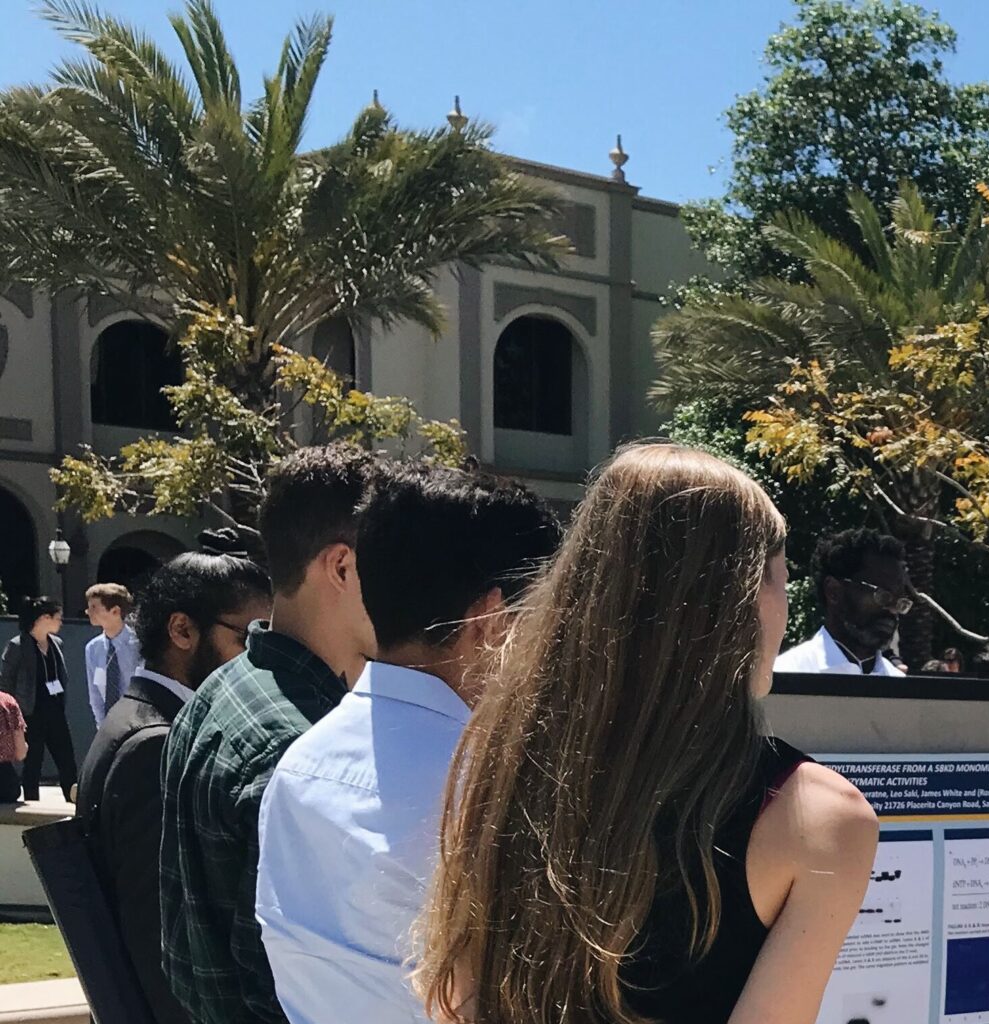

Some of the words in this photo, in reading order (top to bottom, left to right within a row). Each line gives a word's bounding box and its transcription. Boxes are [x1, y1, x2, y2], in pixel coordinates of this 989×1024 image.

[902, 764, 926, 773] FROM
[927, 764, 933, 773] A
[886, 777, 928, 786] ACTIVITIES
[890, 790, 902, 798] Leo
[920, 790, 941, 798] James
[942, 789, 963, 797] White
[964, 788, 976, 797] and
[936, 801, 961, 810] Canyon
[962, 800, 981, 809] Road,
